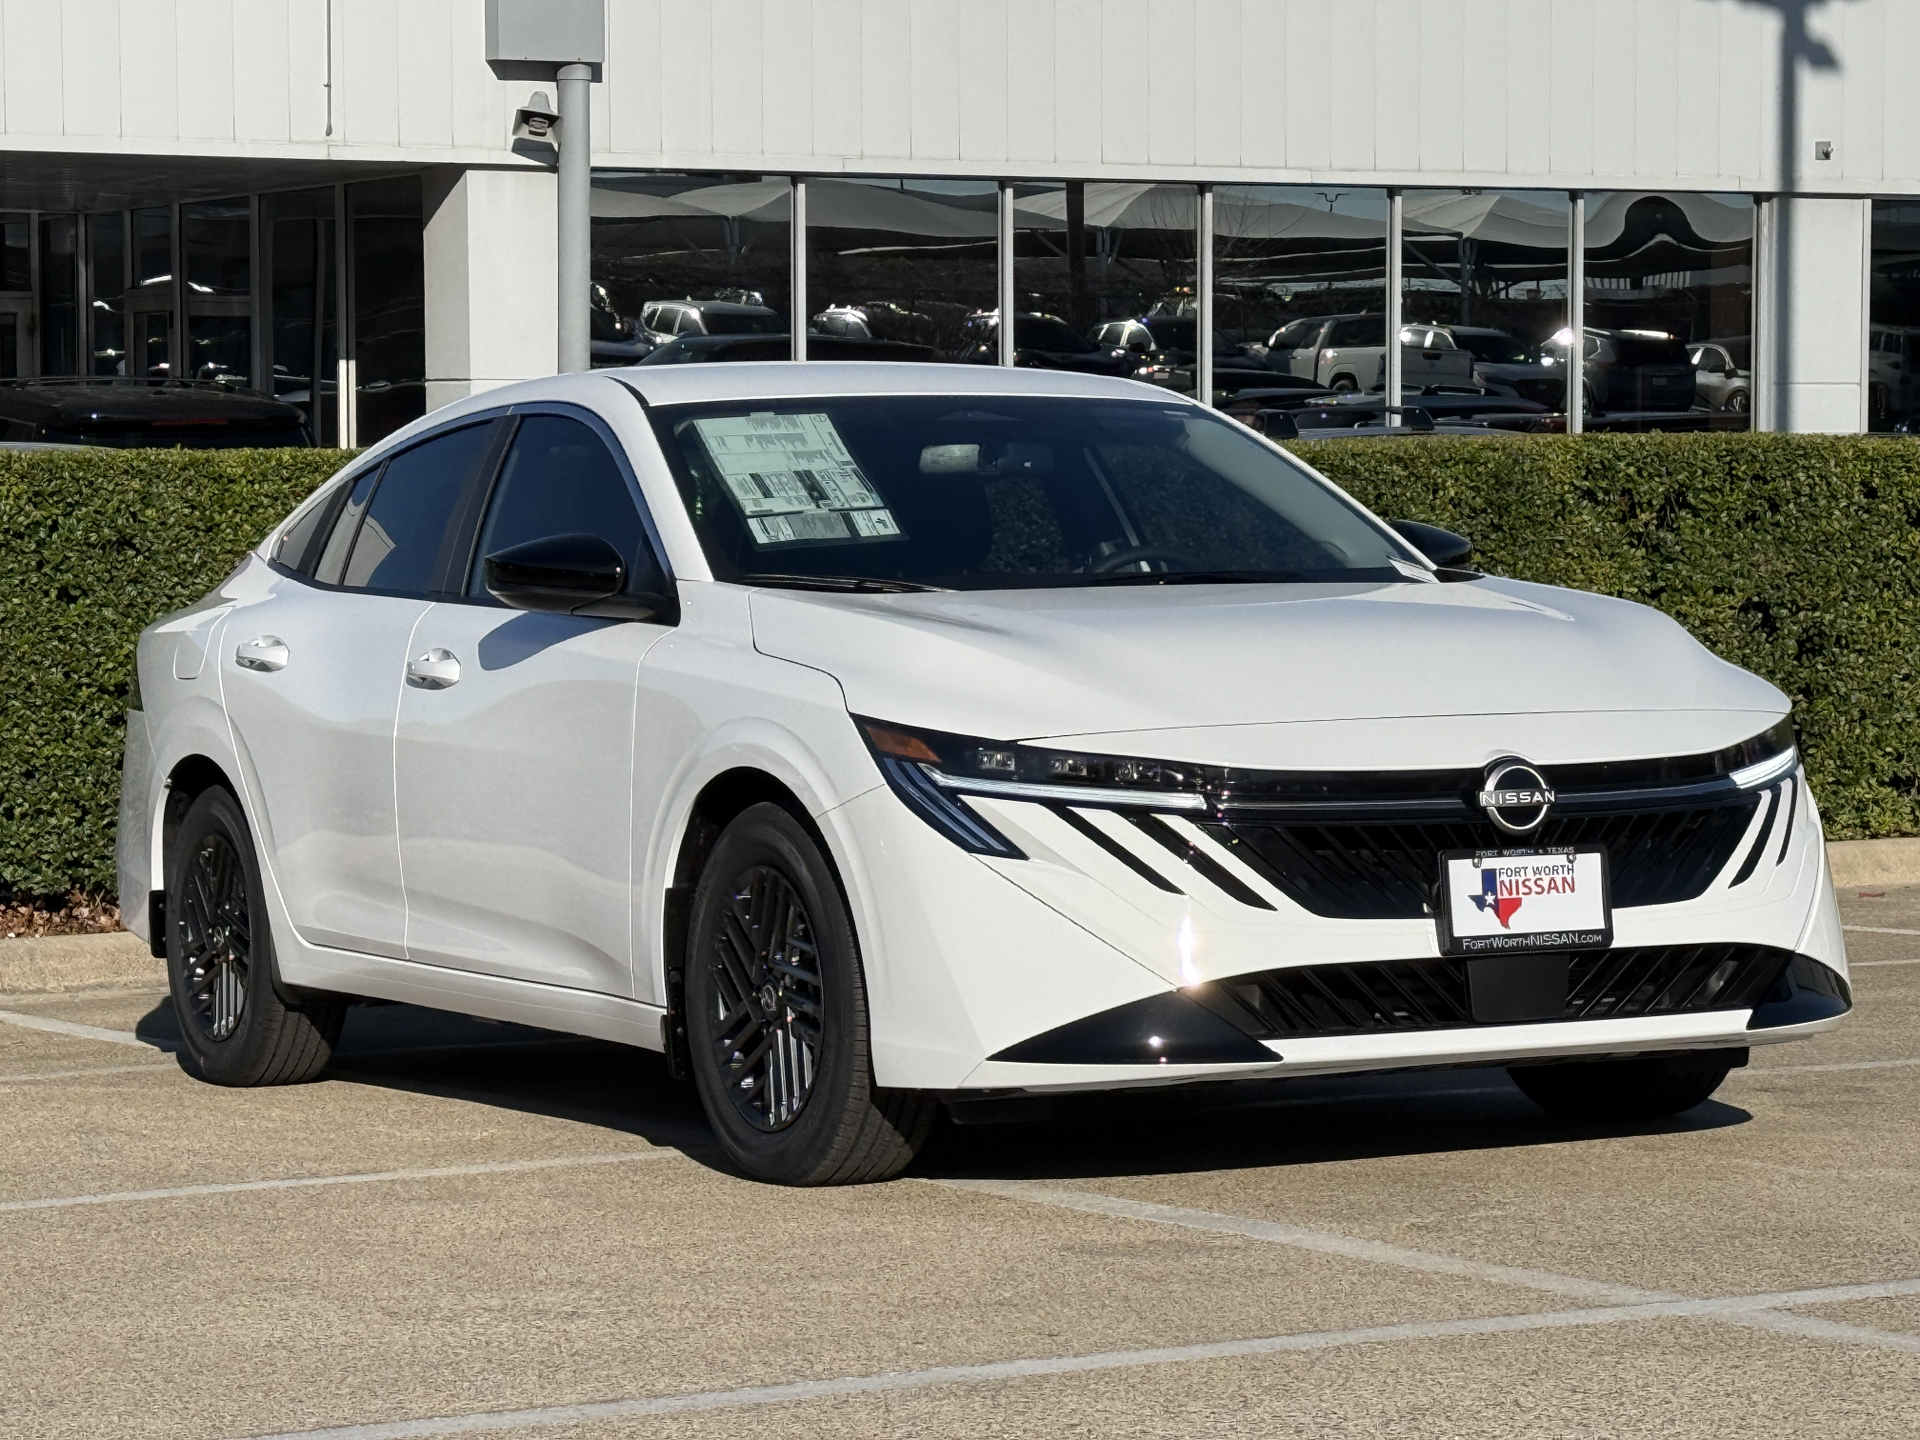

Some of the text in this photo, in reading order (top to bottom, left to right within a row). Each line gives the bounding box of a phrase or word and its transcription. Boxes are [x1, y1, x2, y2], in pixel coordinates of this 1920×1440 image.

[1479, 790, 1556, 806] NISSAN
[1502, 848, 1534, 856] WORTH
[1547, 846, 1575, 854] TEXAS
[1498, 864, 1575, 878] FORT WORTH
[1499, 877, 1576, 897] NISSAN
